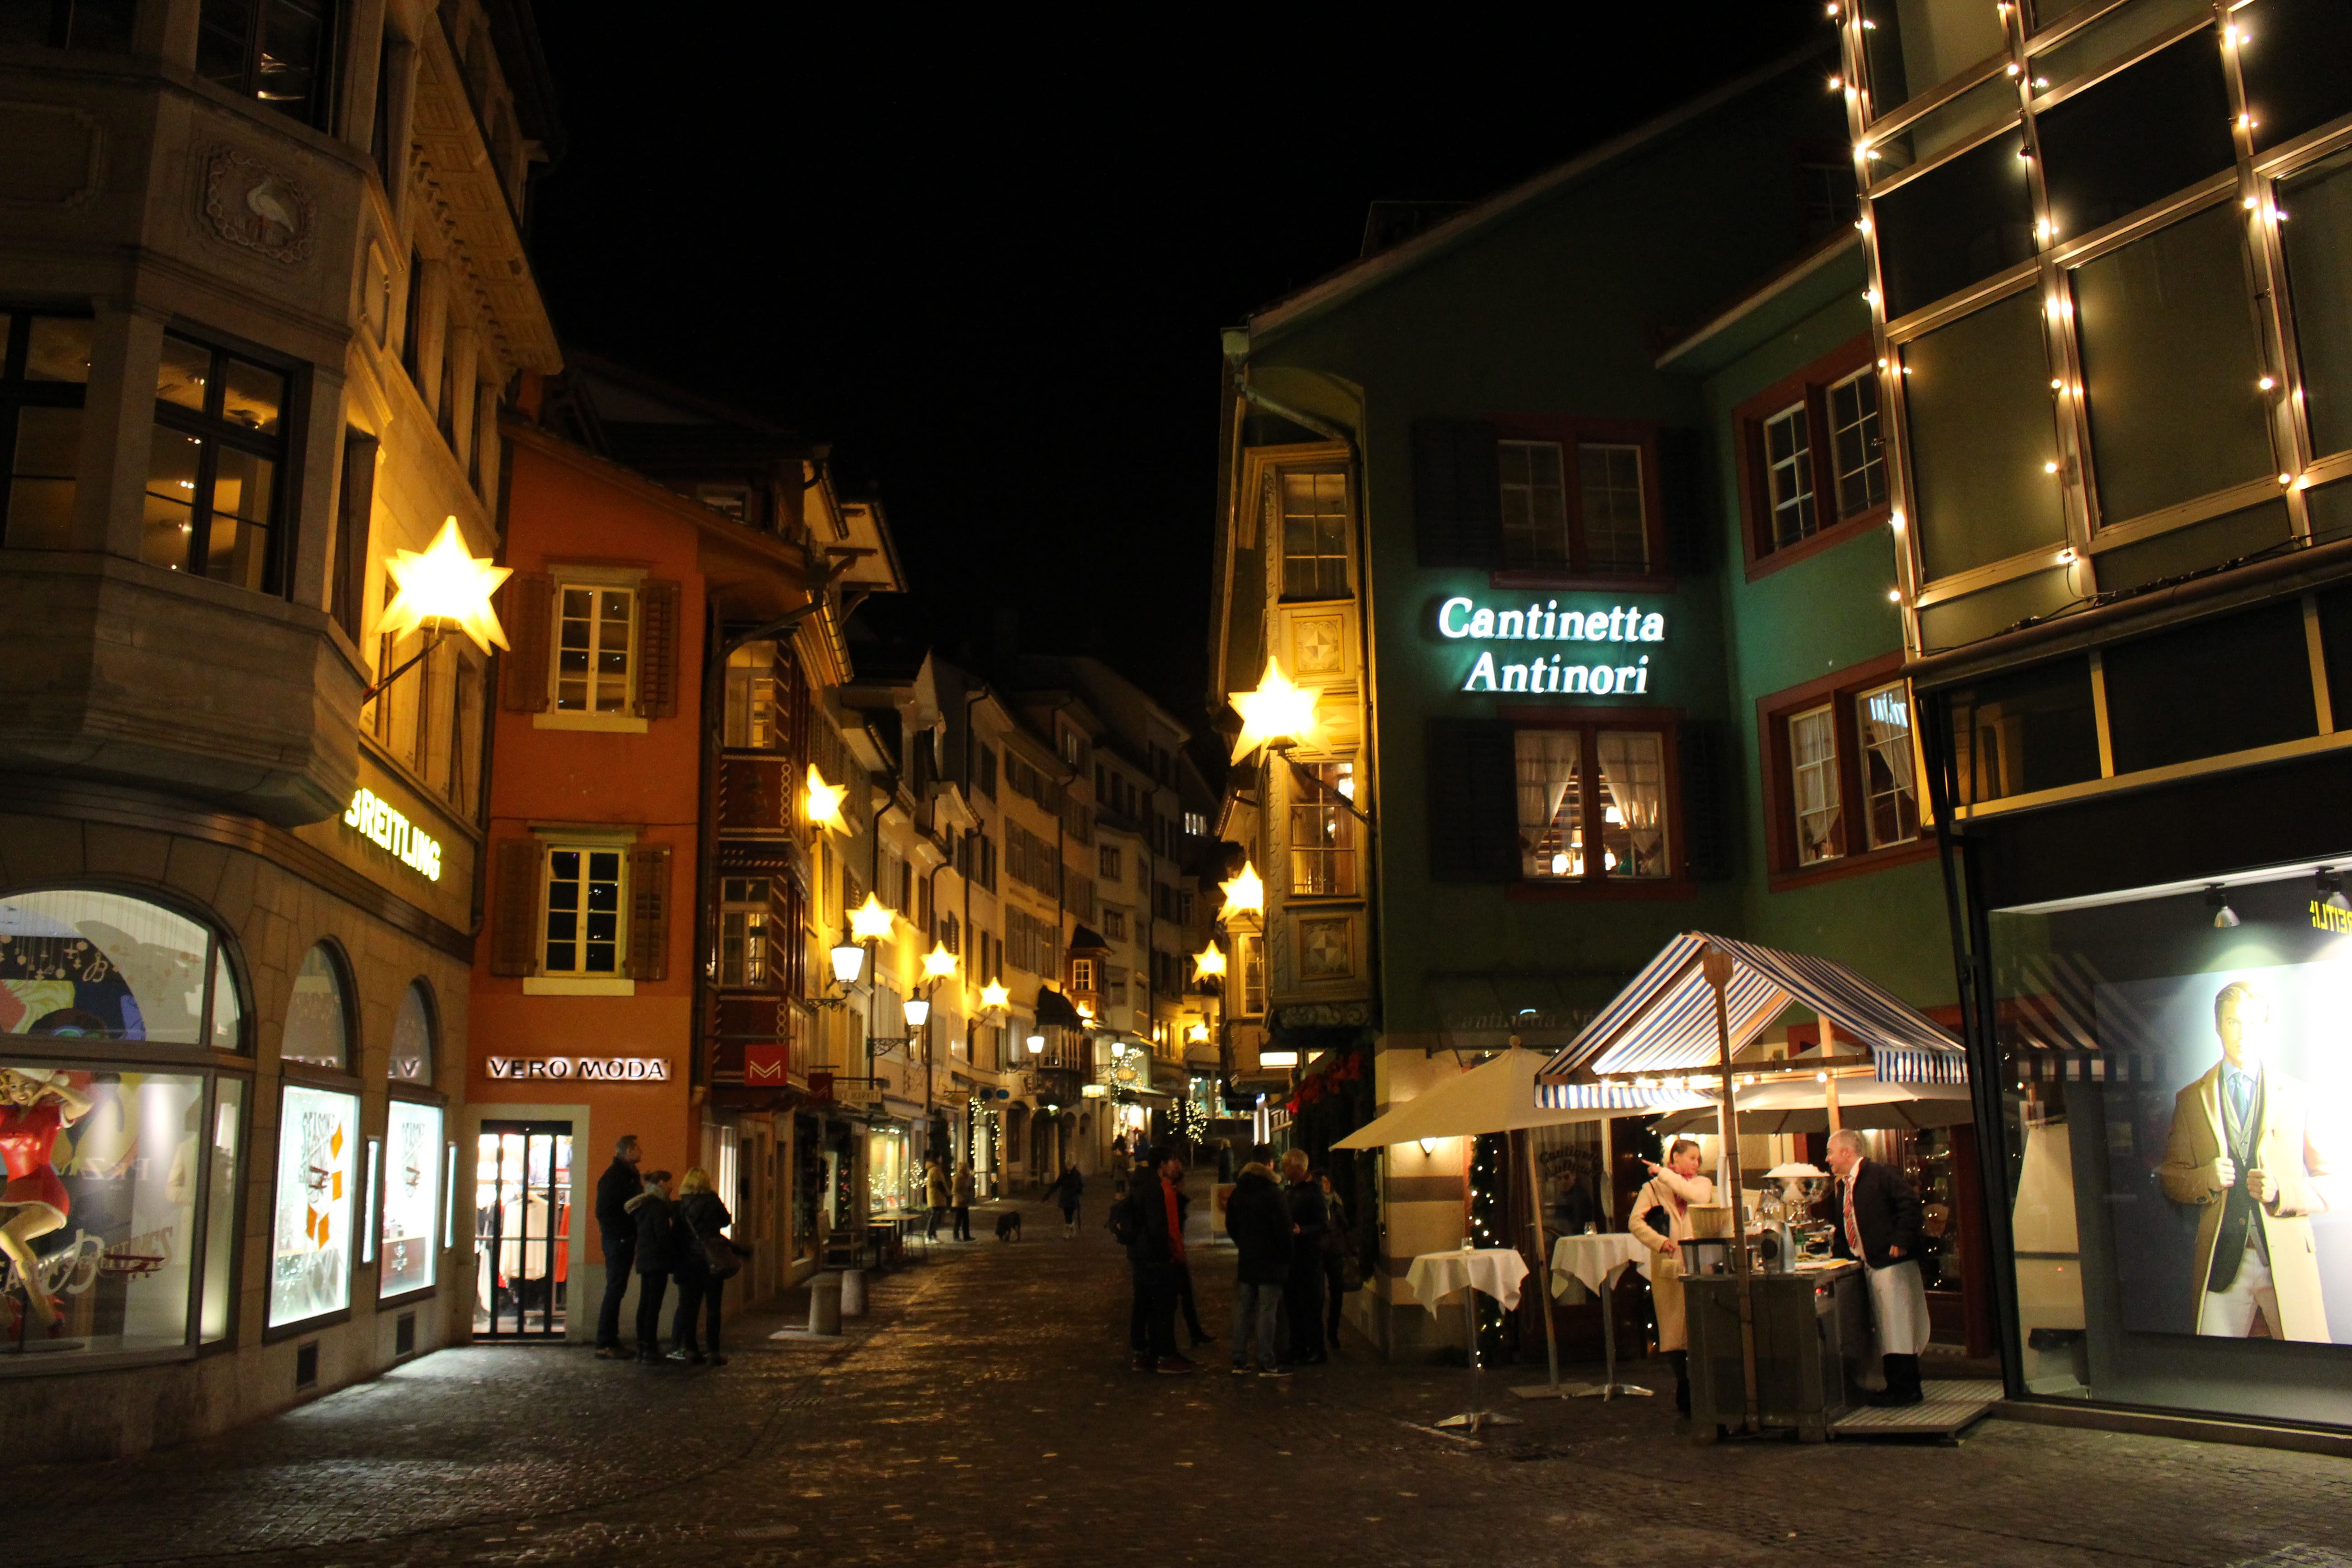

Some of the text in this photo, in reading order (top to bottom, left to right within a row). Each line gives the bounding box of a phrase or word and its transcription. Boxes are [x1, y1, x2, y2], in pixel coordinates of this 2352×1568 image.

[1438, 597, 1665, 642] Cantinetta
[1460, 651, 1649, 695] Antinori
[490, 1060, 664, 1078] VERO MODA
